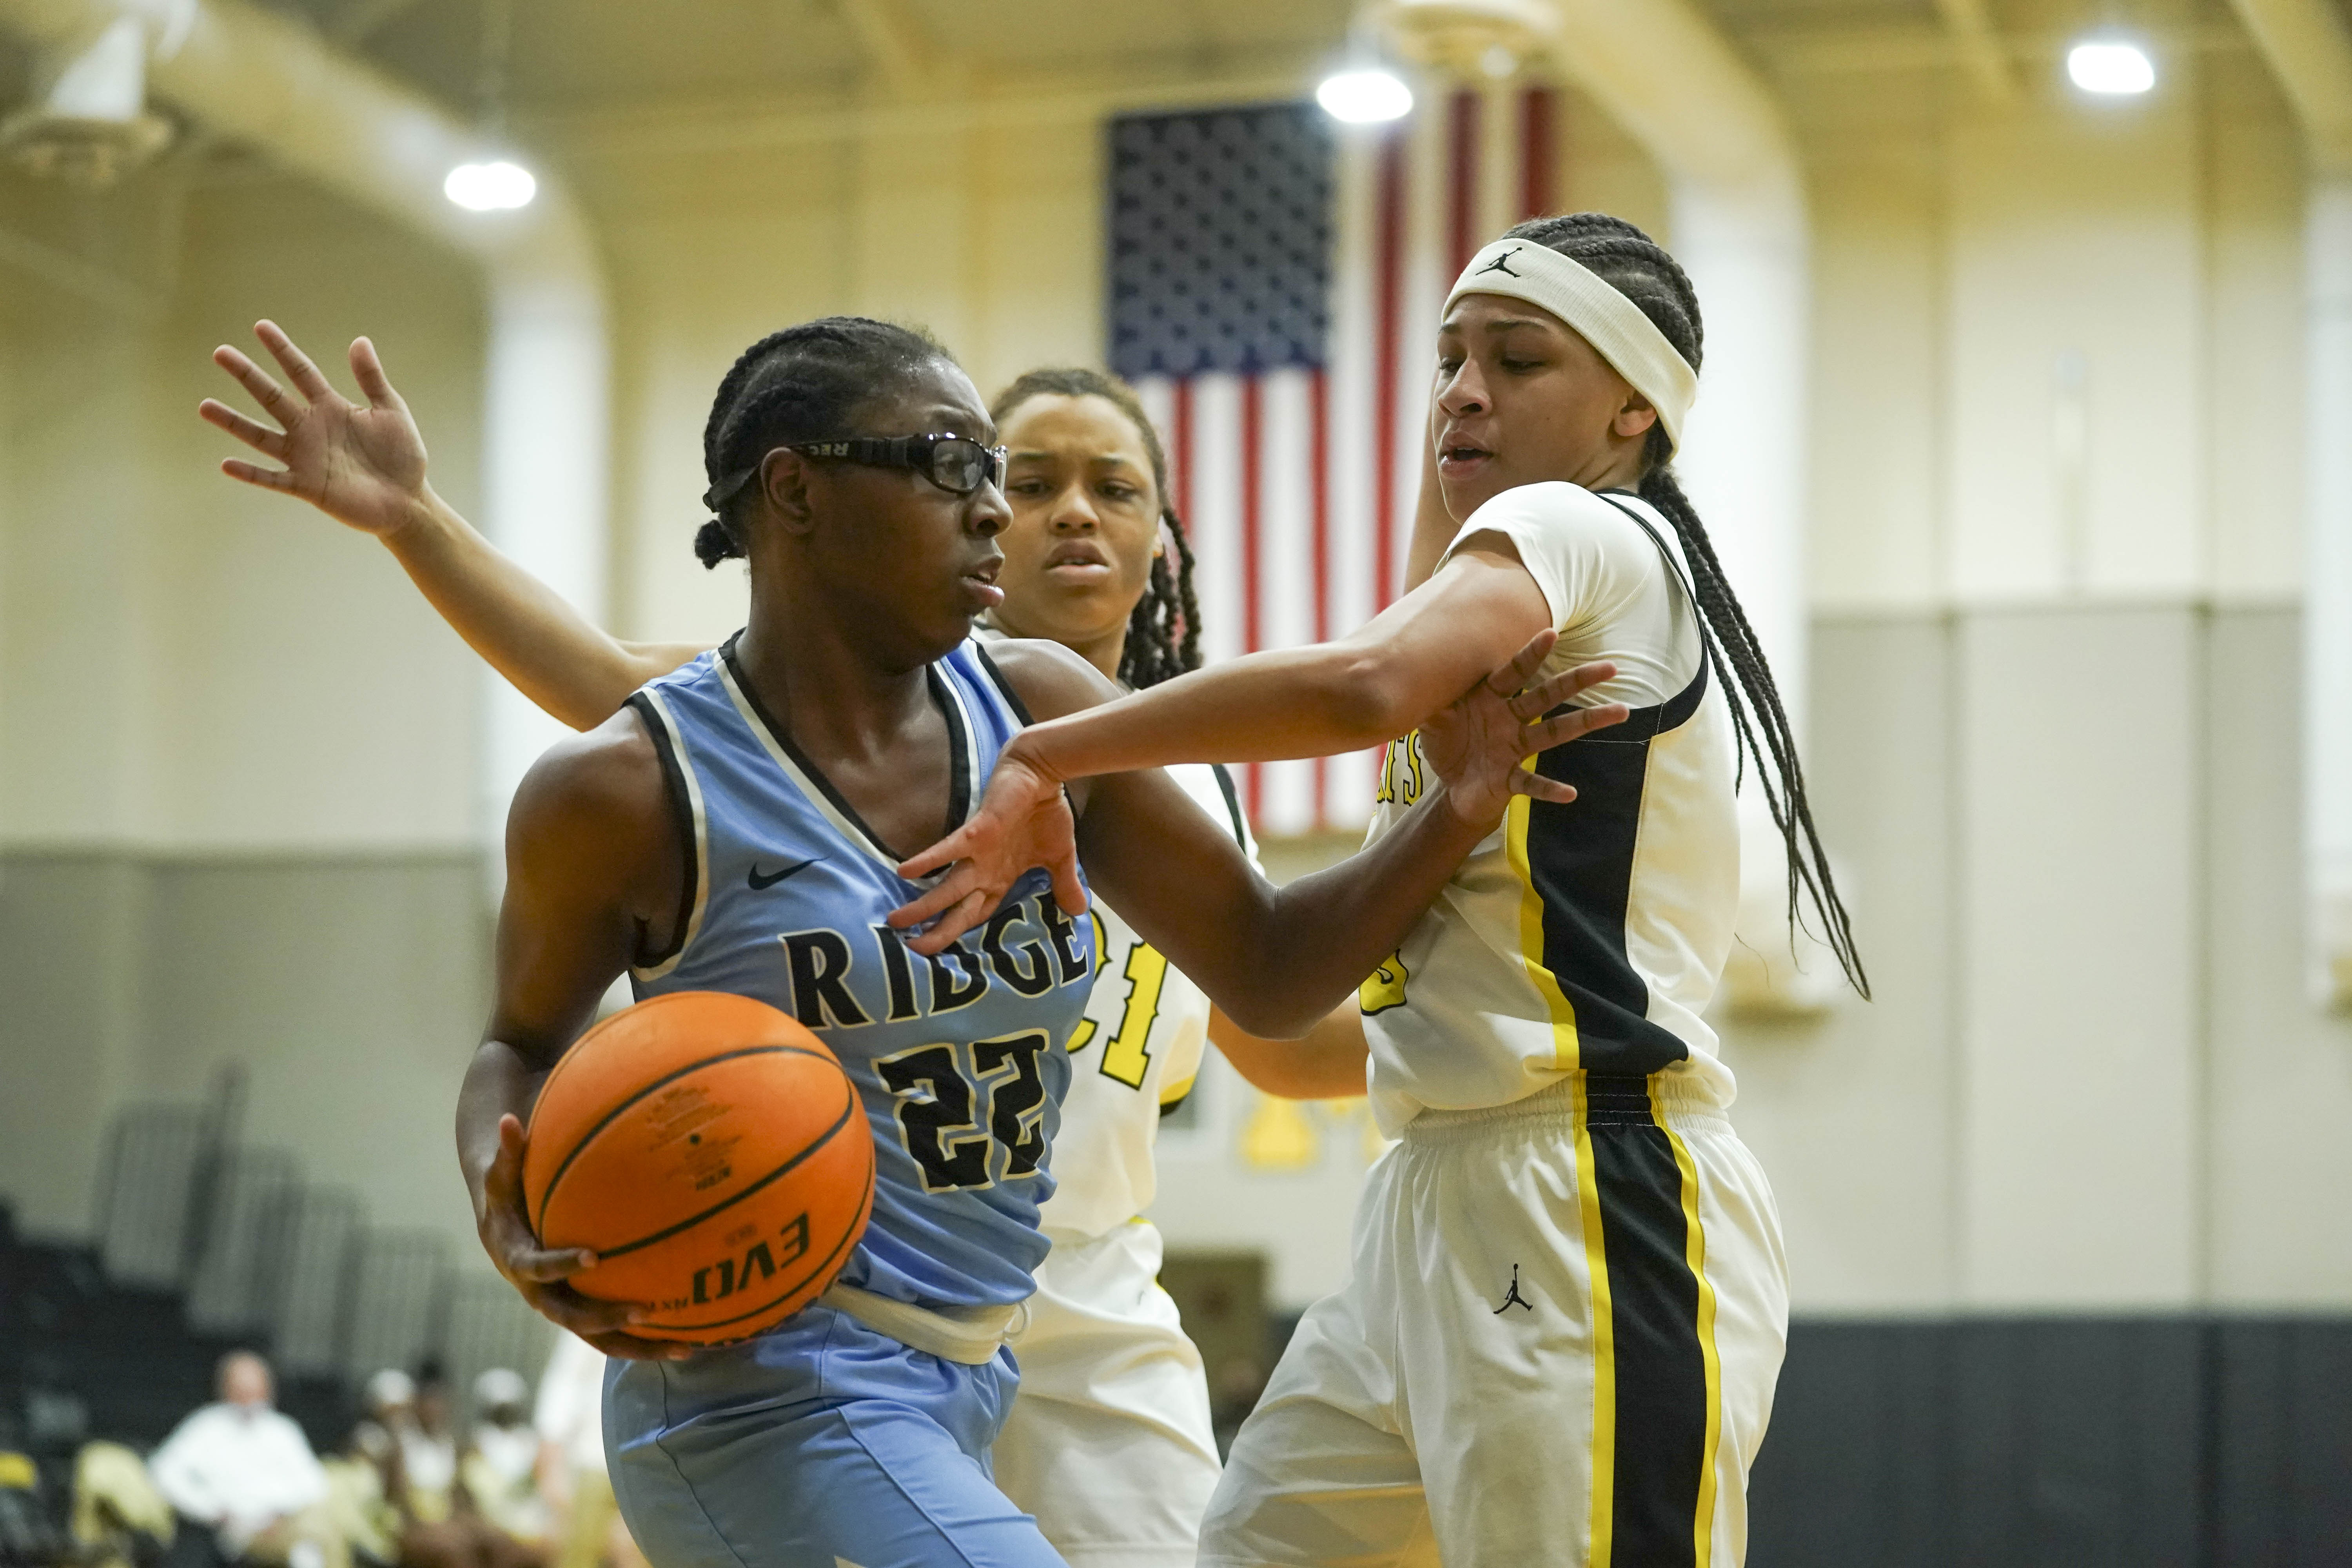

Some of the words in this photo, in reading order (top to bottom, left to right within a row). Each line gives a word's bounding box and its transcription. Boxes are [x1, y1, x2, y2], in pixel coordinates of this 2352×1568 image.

[778, 889, 1089, 1031] RIDGE
[871, 1027, 1051, 1194] 22
[692, 1211, 810, 1305] EVO
